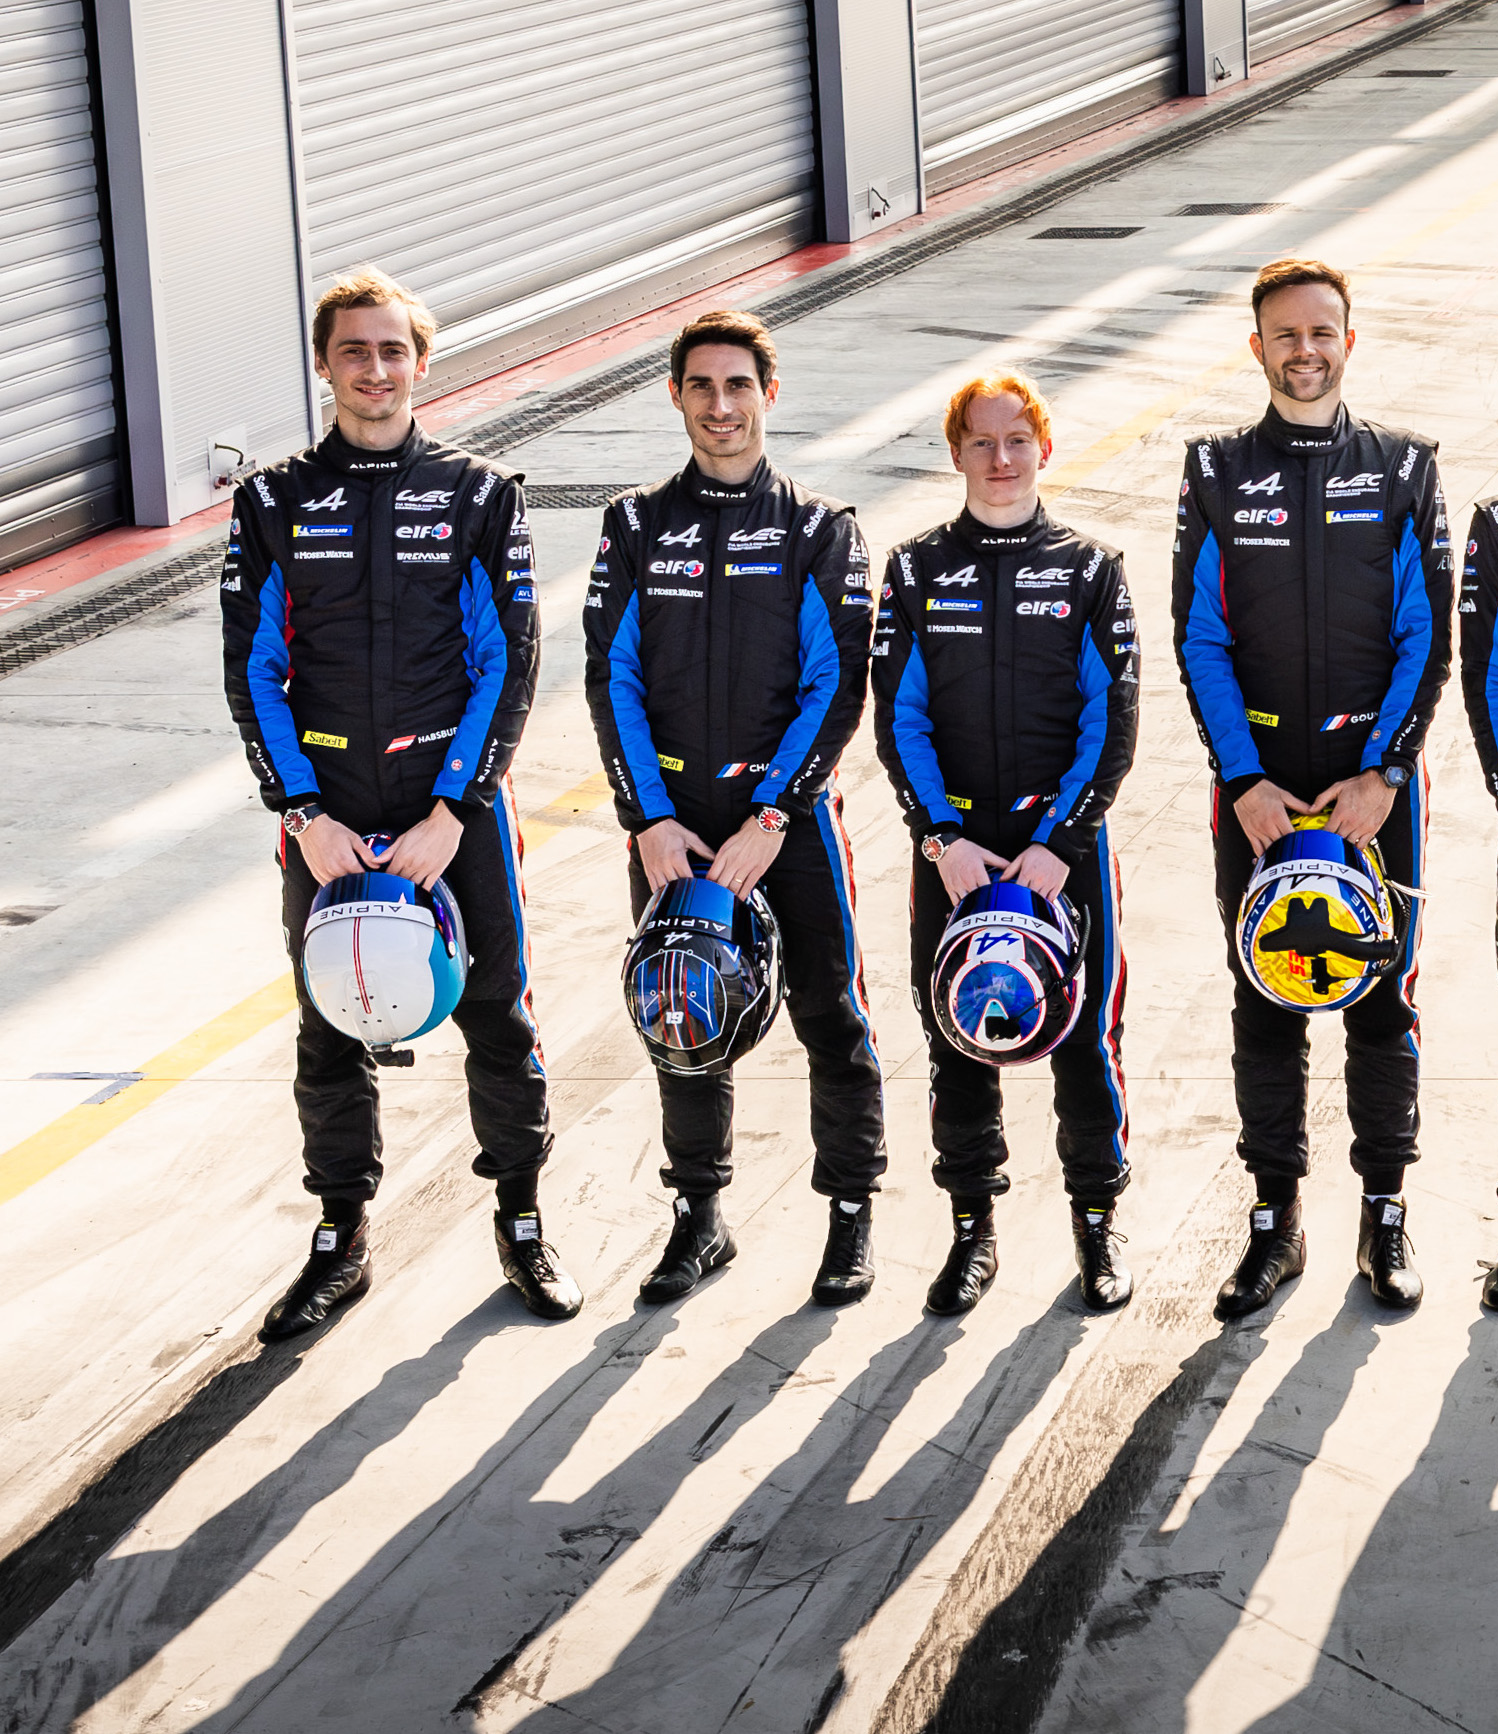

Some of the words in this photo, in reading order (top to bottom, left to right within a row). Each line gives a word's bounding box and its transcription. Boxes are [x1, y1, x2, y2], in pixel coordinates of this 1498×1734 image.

[1290, 440, 1333, 448] ALPINE
[350, 461, 398, 470] ALPINE
[1198, 444, 1216, 479] Sabelt
[1398, 445, 1419, 481] Sabelt
[473, 471, 498, 506] Sabelt
[1326, 473, 1384, 489] WEC
[253, 474, 276, 508] Sabelt
[395, 489, 456, 504] WEC
[700, 488, 747, 499] ALPINE
[622, 496, 641, 532] Sabelt
[803, 501, 829, 538] Sabelt
[1234, 508, 1269, 523] elf
[395, 525, 432, 539] elf
[728, 526, 788, 542] WEC
[981, 536, 1027, 545] ALPINE
[507, 545, 532, 560] elf
[650, 560, 685, 574] elf
[899, 552, 916, 587] Sabelt
[1082, 547, 1106, 582] Sabelt
[845, 573, 865, 587] elf
[1015, 567, 1074, 581] WEC
[518, 590, 532, 598] AVL
[1016, 601, 1050, 615] elf
[1246, 710, 1275, 725] Sabelt
[1351, 711, 1379, 724] GOUN
[308, 732, 342, 747] Sabelt
[418, 726, 457, 744] HABSBUR
[477, 738, 499, 784] ALPINE
[658, 756, 679, 770] abelt
[749, 763, 770, 773] CHA
[947, 797, 968, 808] belt
[1268, 863, 1349, 877] ALPINE
[320, 904, 402, 920] ALPINE
[646, 918, 727, 932] ALPINE
[962, 914, 1044, 929] ALPINE
[1242, 893, 1267, 960] ALPIN
